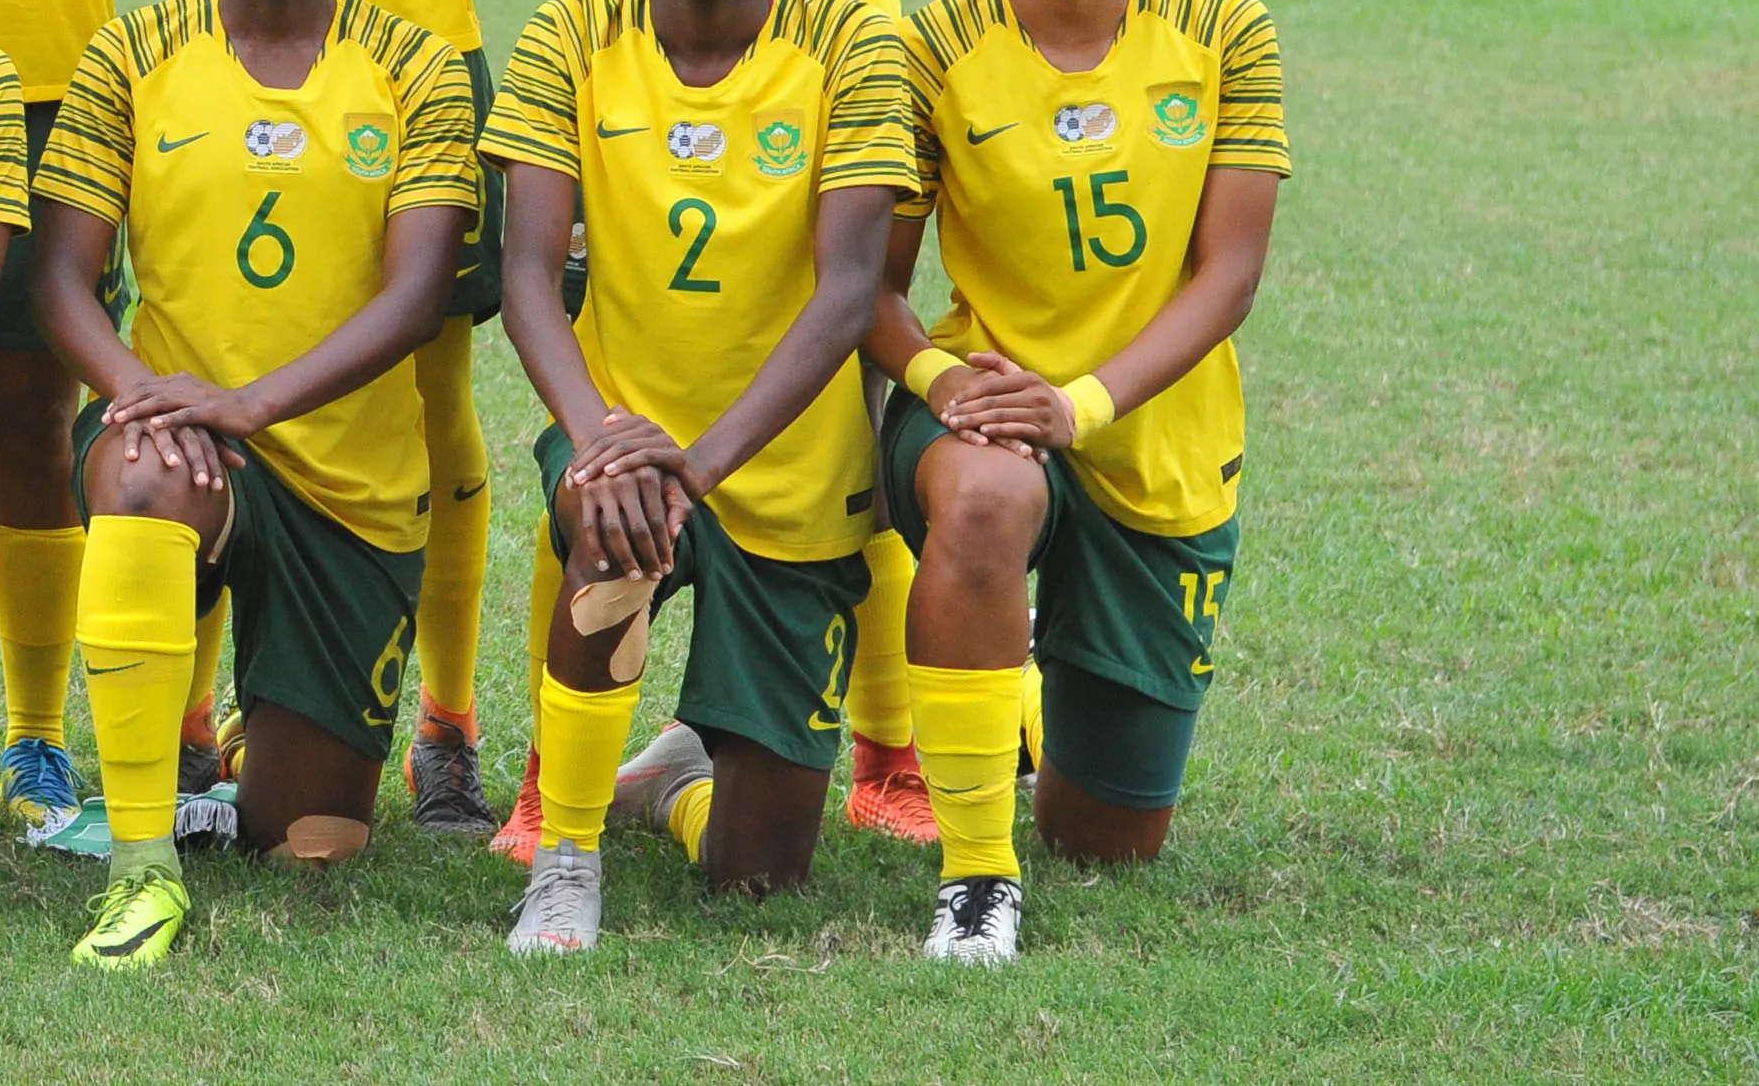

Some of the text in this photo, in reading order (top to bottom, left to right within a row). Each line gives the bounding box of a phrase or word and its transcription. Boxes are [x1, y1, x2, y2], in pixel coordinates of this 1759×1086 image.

[236, 191, 295, 289] 6
[667, 197, 721, 293] 2
[1053, 169, 1148, 272] 15
[371, 616, 408, 707] 6
[822, 614, 846, 708] 2
